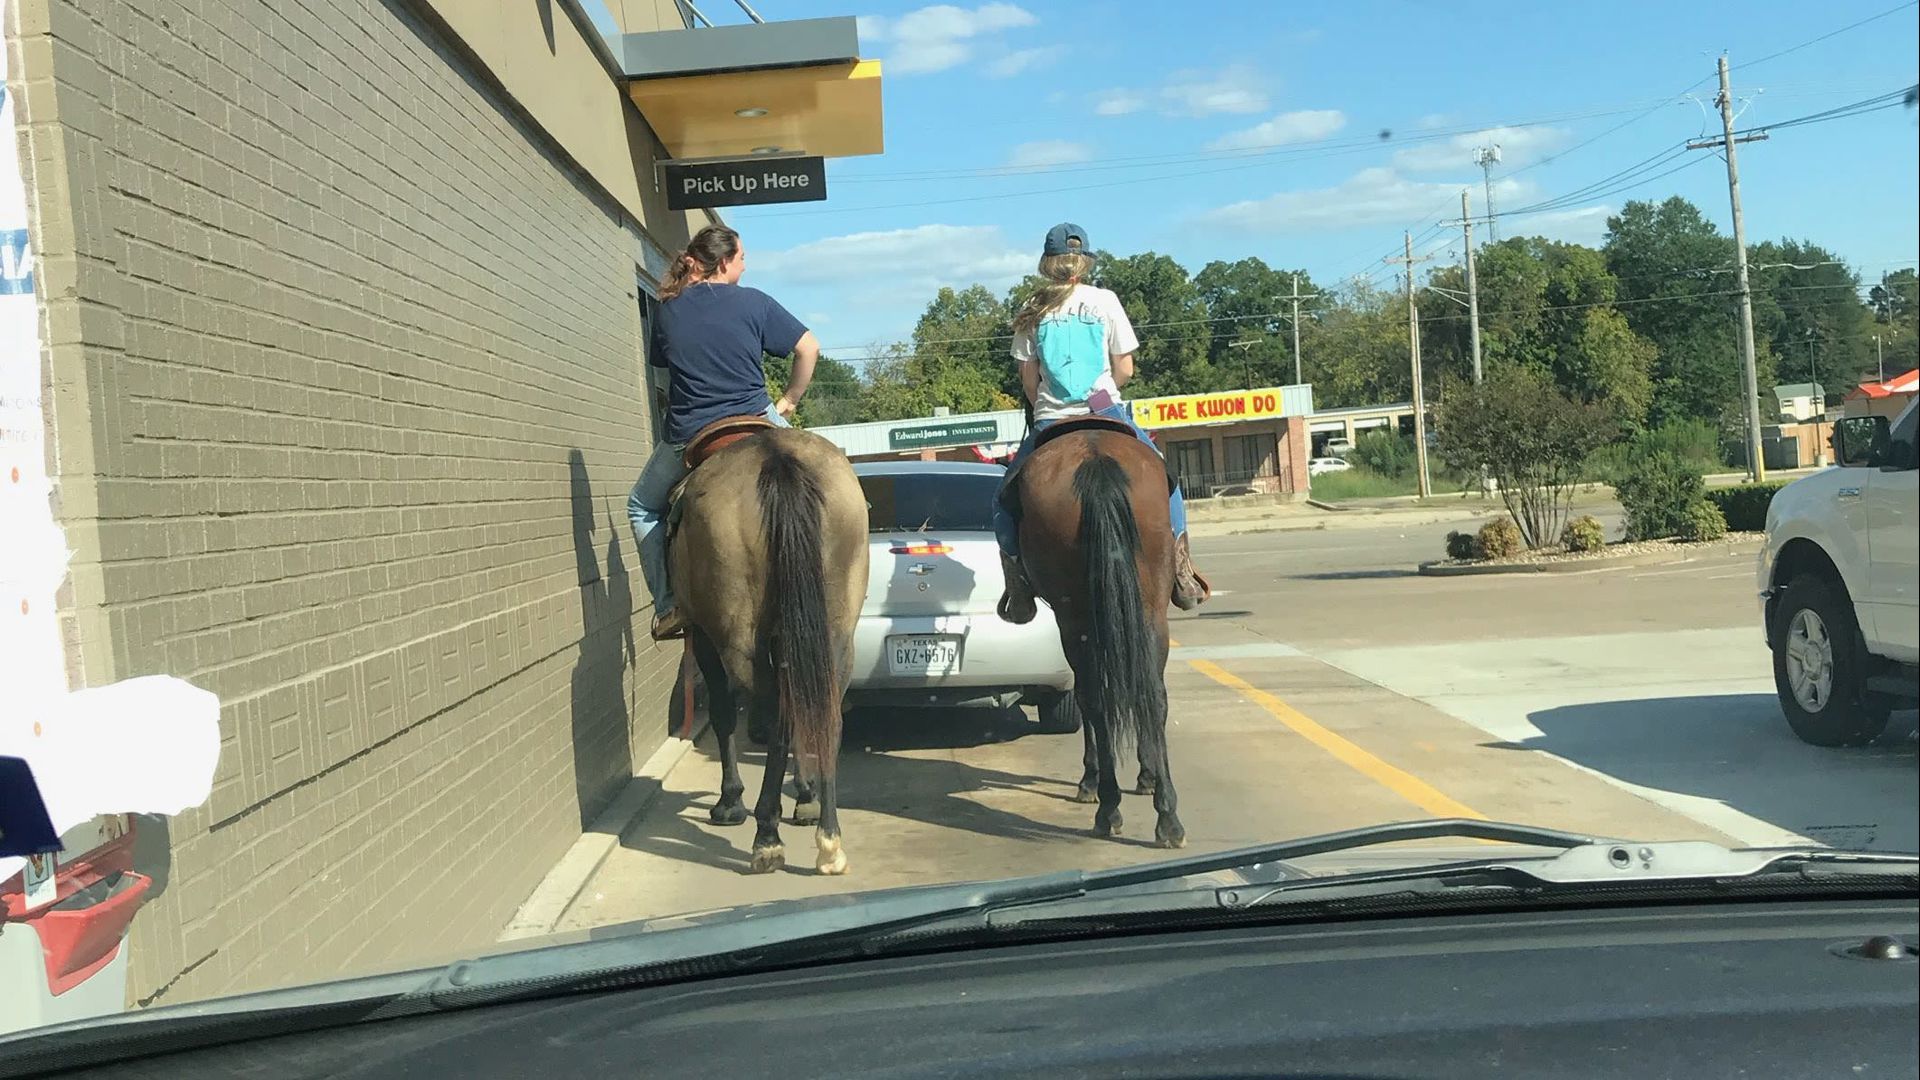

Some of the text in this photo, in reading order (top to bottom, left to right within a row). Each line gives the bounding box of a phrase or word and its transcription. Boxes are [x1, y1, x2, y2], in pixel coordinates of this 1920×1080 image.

[683, 172, 810, 194] Pick Up Here
[1156, 394, 1276, 421] TAE KWON DO
[952, 426, 995, 435] INVESTMENTS
